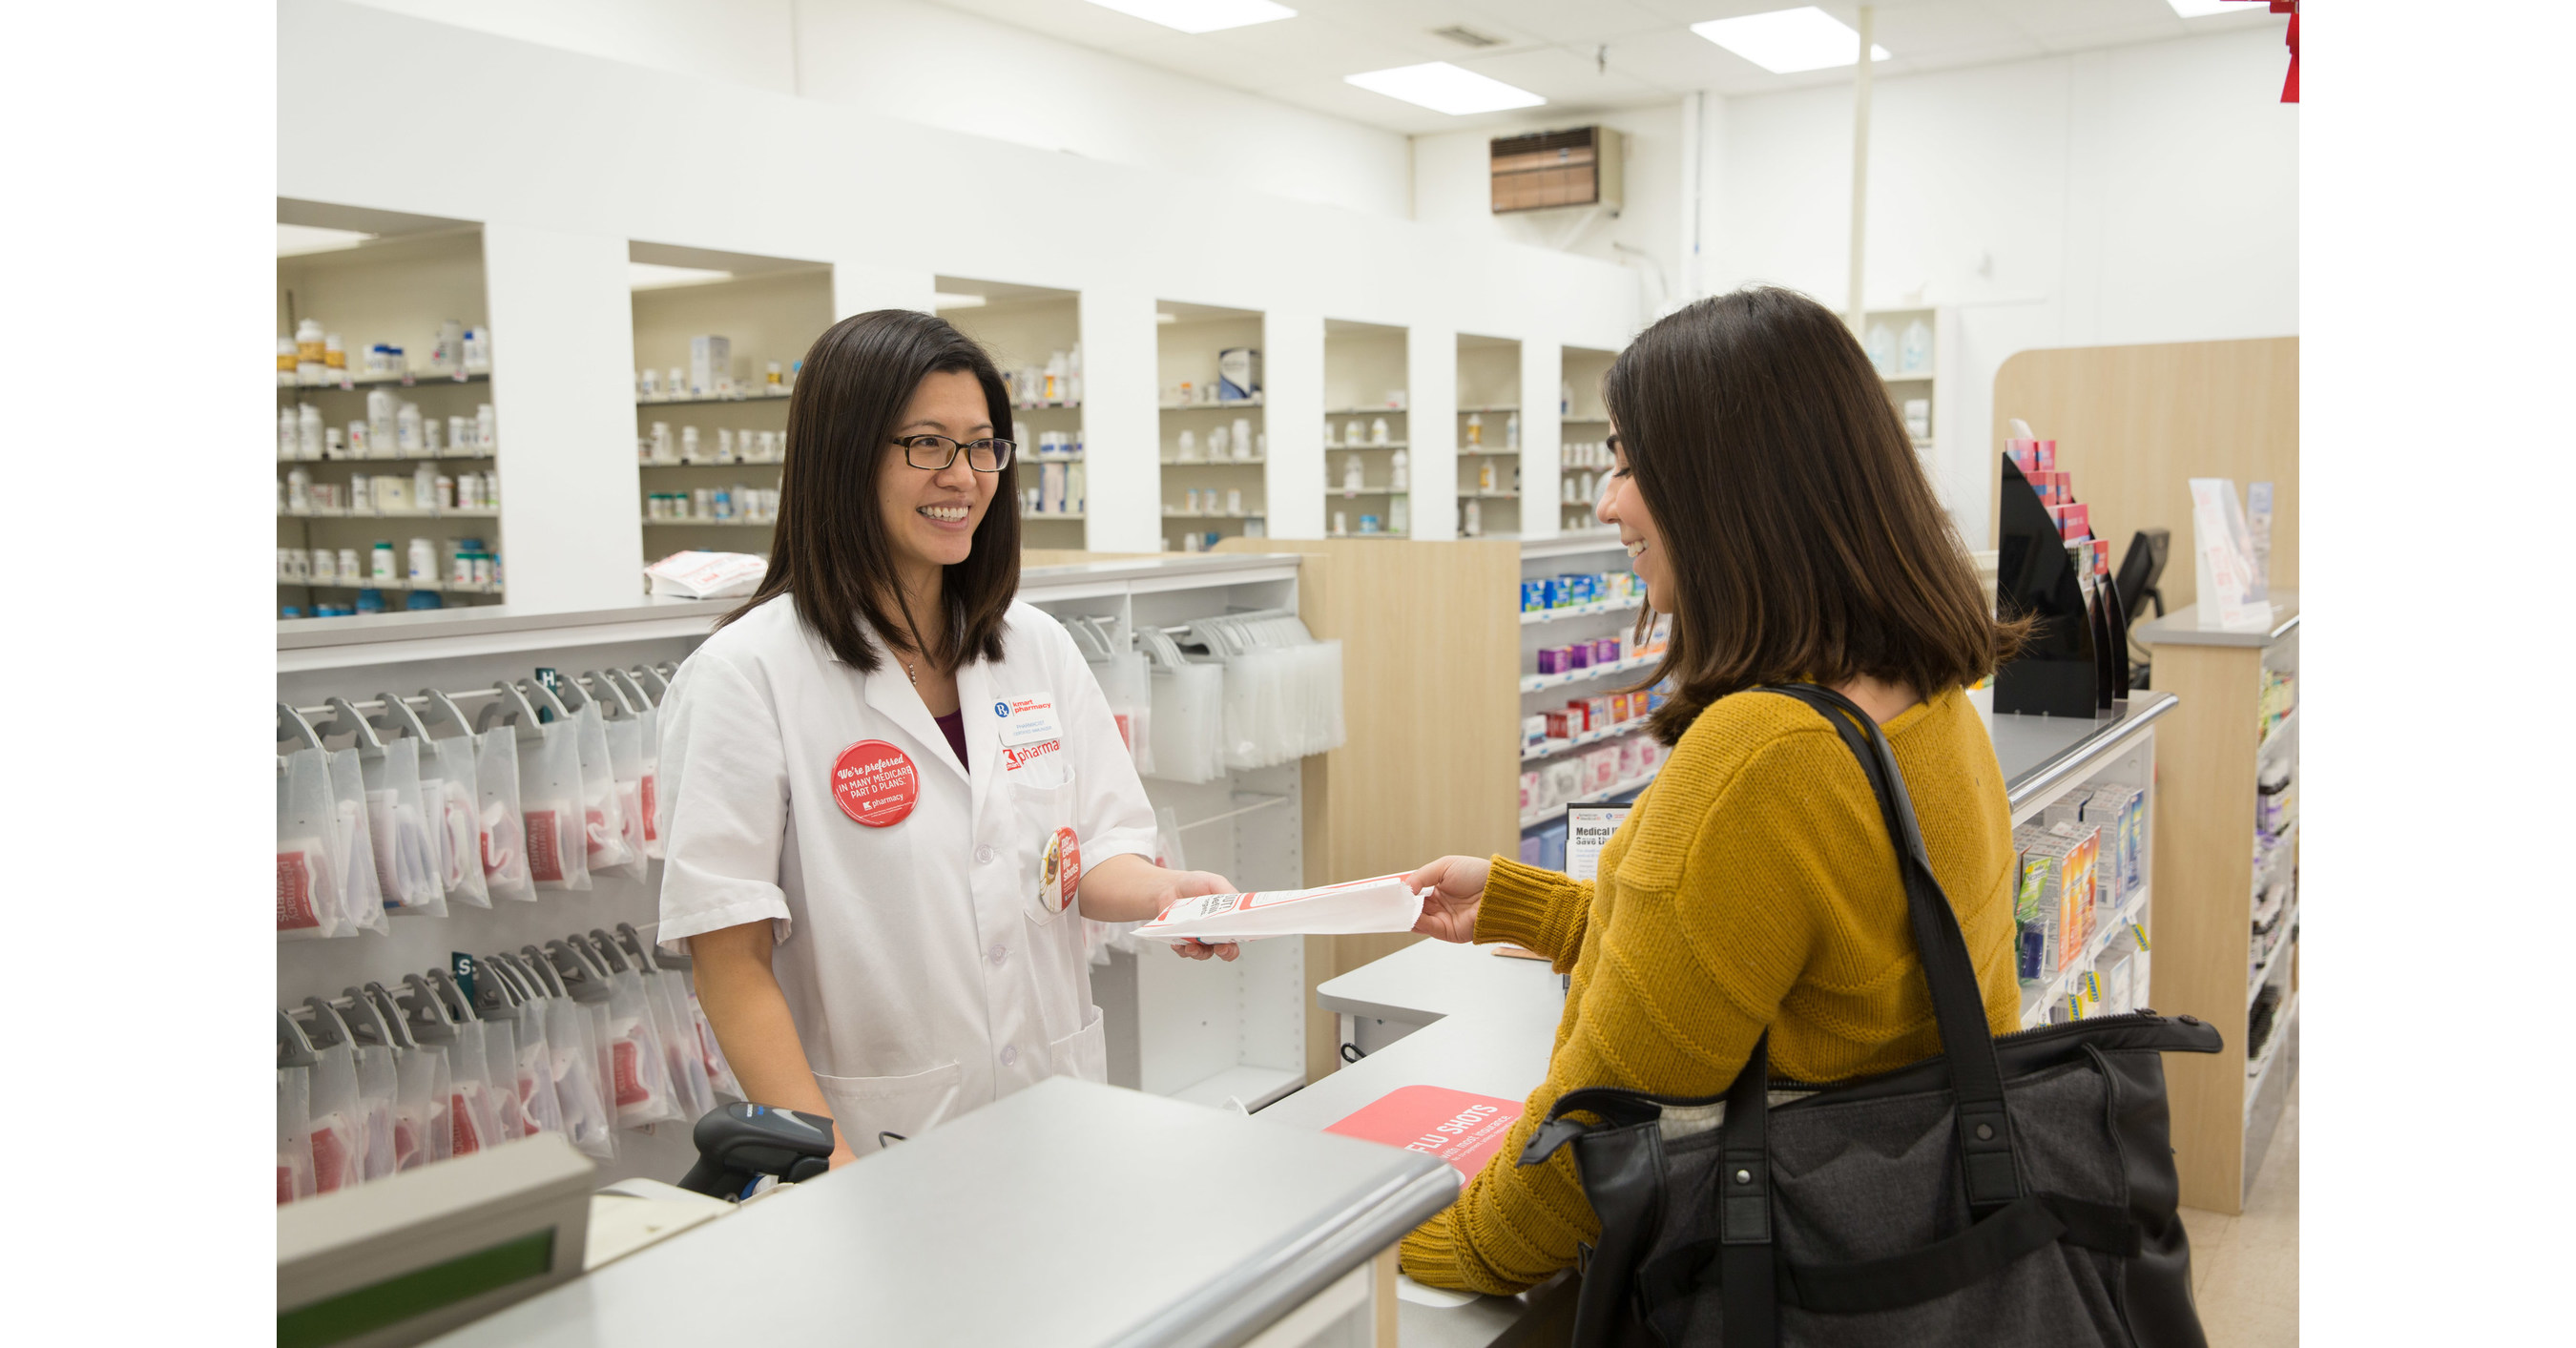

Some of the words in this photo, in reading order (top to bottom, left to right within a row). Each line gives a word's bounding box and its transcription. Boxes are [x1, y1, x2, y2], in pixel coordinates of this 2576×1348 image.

[543, 671, 554, 687] H
[1014, 703, 1050, 714] pharmacy
[1017, 739, 1061, 764] pharma
[838, 766, 864, 779] We're
[864, 754, 904, 776] preferred
[839, 783, 848, 793] IN
[849, 777, 871, 790] MANY
[873, 765, 912, 783] MEDICARE
[850, 787, 870, 798] PART
[872, 794, 904, 808] pharmacy
[1576, 827, 1610, 836] Medical
[1576, 837, 1597, 845] Save
[1062, 840, 1075, 859] cost
[1063, 858, 1071, 870] flu
[1064, 863, 1079, 881] shots
[280, 860, 301, 921] pharmacy
[459, 959, 470, 975] S
[2087, 971, 2099, 1003] CLEARANCE
[1403, 1133, 1449, 1153] FLU
[1436, 1105, 1498, 1134] SHOTS
[1456, 1135, 1480, 1149] most
